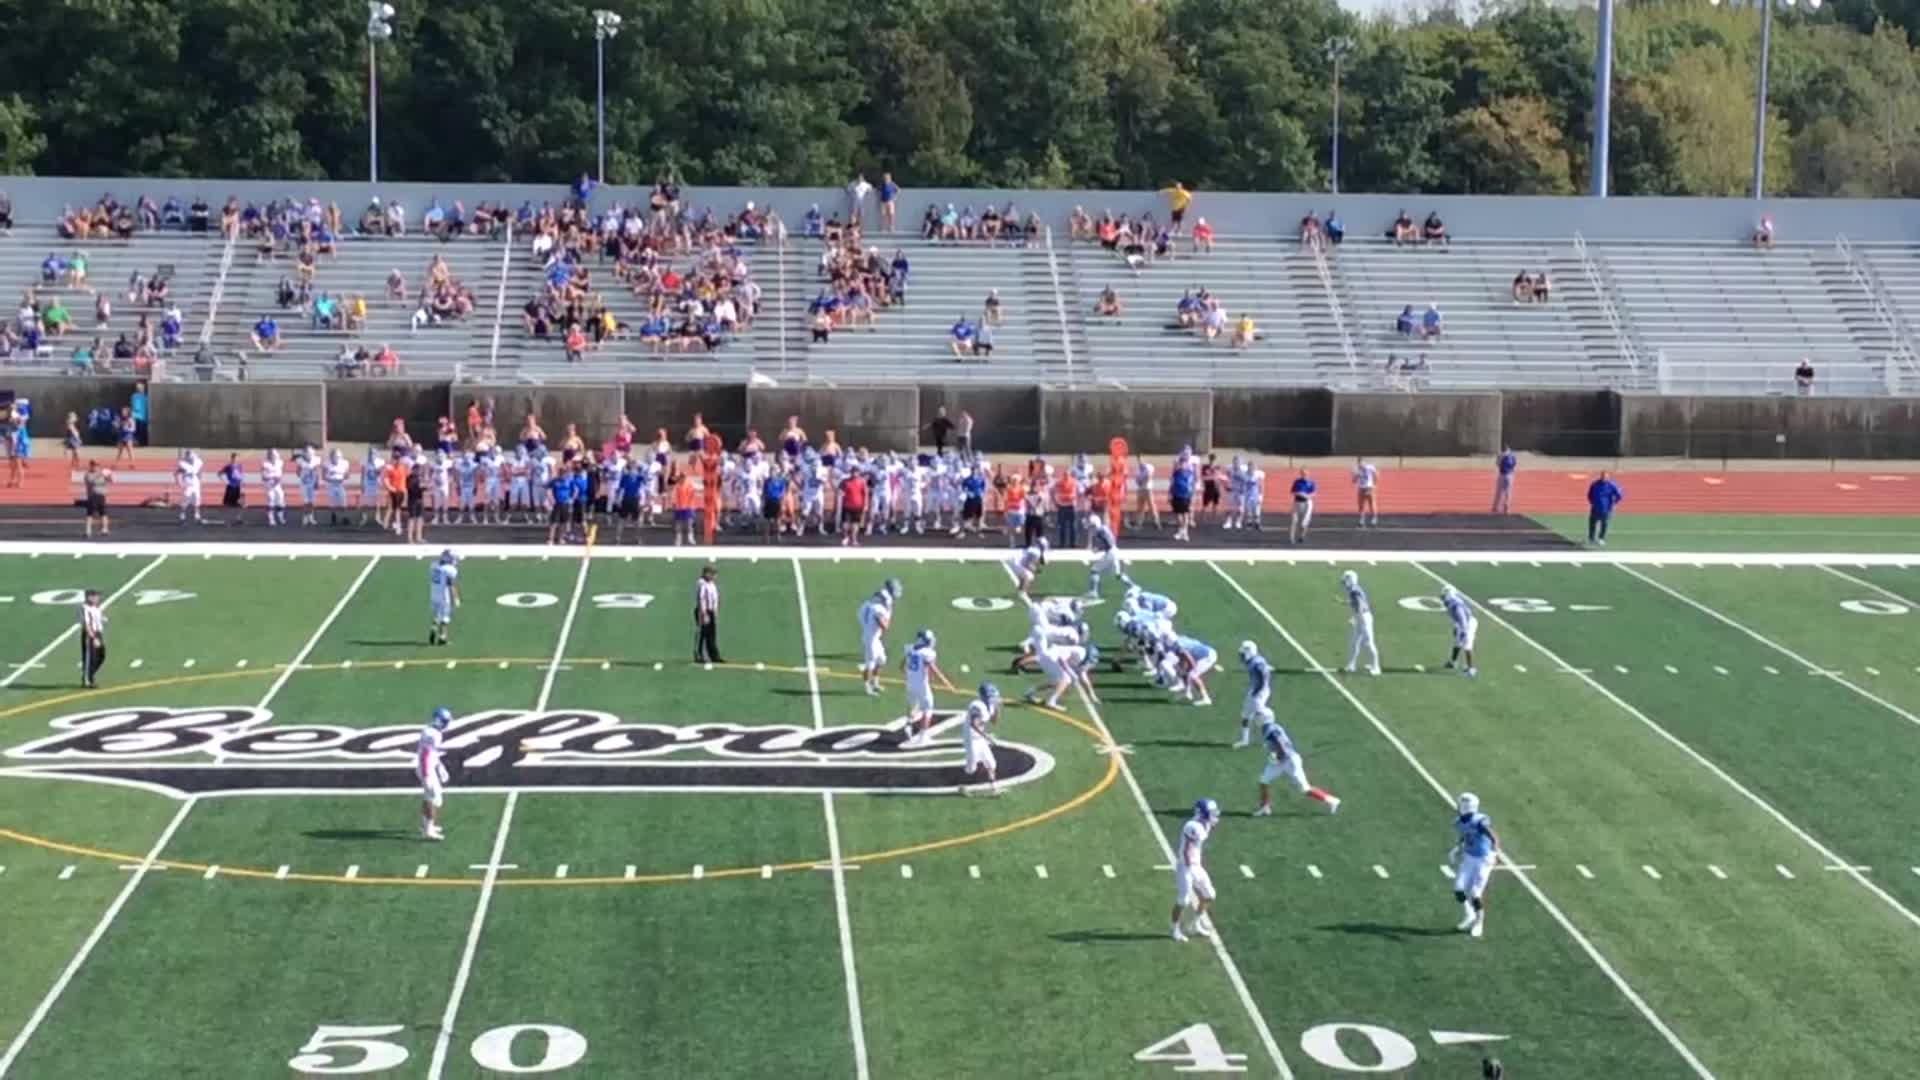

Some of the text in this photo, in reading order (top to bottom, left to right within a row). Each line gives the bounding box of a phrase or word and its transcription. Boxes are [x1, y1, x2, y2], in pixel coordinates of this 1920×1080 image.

[3, 707, 970, 768] Bedford
[288, 1024, 588, 1073] 50
[1133, 1023, 1418, 1072] 40
